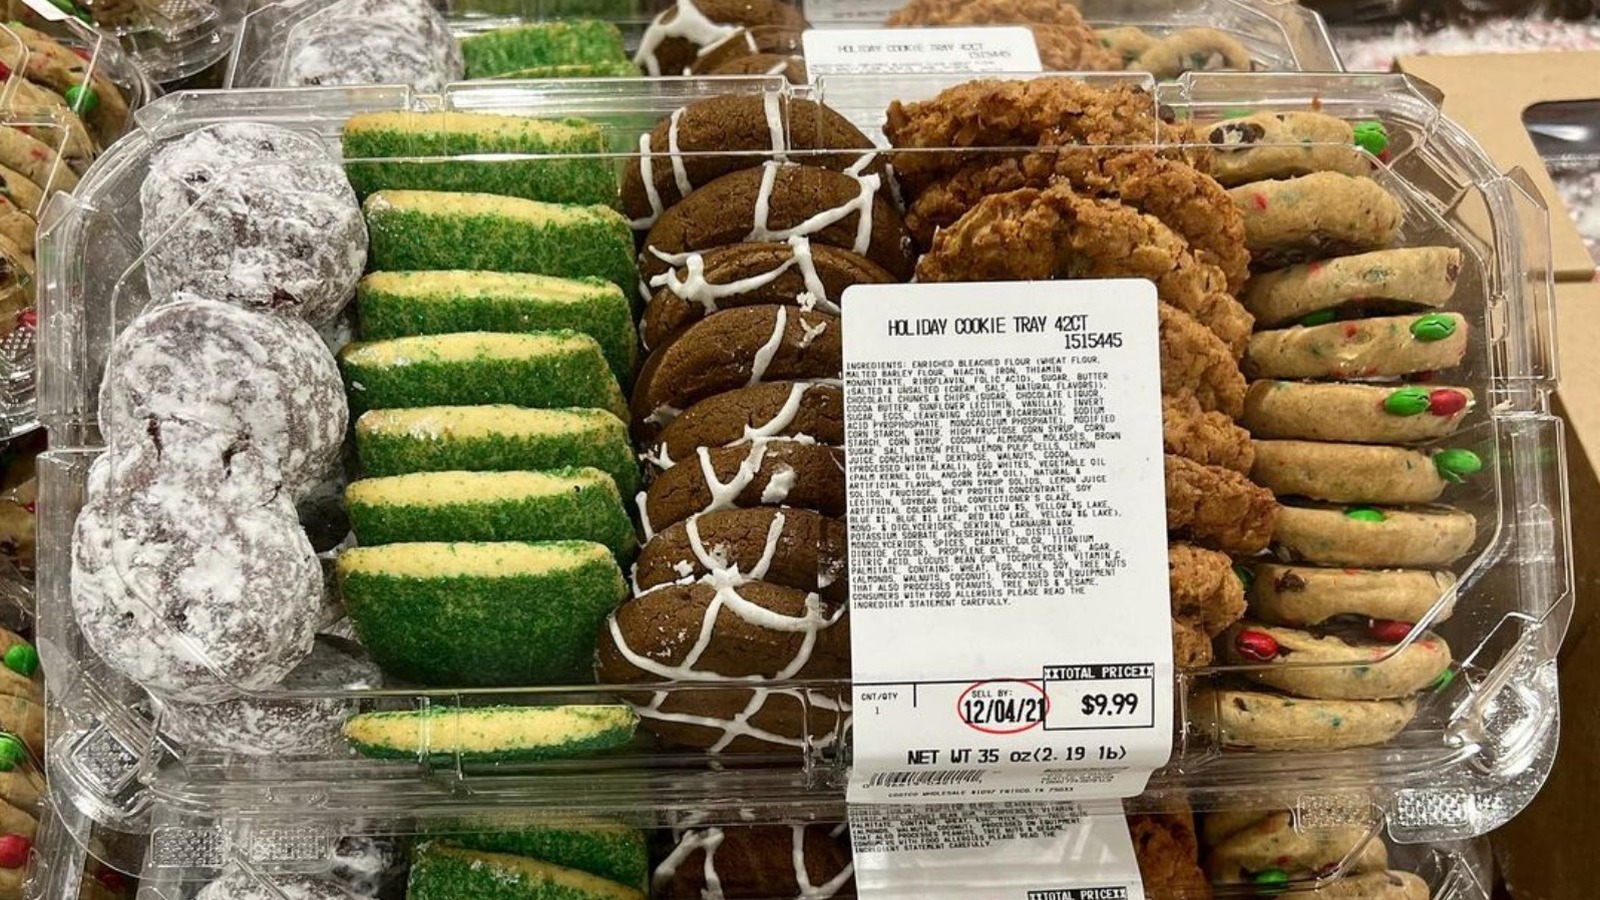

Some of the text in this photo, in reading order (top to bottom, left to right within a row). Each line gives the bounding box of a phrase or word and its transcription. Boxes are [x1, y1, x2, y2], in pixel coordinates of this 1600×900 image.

[888, 314, 1088, 336] HOLIDAY COOKIE TRAY 42CT
[1065, 332, 1123, 350] 1515445
[846, 361, 905, 370] INGREDIENTS:
[912, 360, 952, 368] ENRICHED
[958, 358, 998, 366] BLEACHED
[845, 365, 1061, 378] MALTED BARLEY THIAMIN
[1077, 372, 1107, 380] BUTTER
[897, 386, 938, 394] UNSALTED
[846, 396, 892, 404] CHOCOLATE
[944, 393, 969, 401] CHIPS
[1016, 391, 1061, 399] CHOCOLATE
[918, 402, 964, 410] SUNFLOWER
[1074, 398, 1103, 406] INVERT
[913, 411, 959, 419] LEAVENING
[950, 418, 1006, 426] MONOCALCIUM
[1073, 415, 1114, 423] MODIFIED
[847, 430, 867, 438] CORN
[976, 426, 1016, 434] FRUCTOSE
[1069, 441, 1094, 449] LEMON
[1038, 459, 1084, 467] VEGETABLE
[879, 472, 909, 480] KERNEL
[941, 470, 971, 478] AND/OR
[1034, 467, 1069, 475] NATURAL
[849, 481, 899, 489] ARTIFICIAL
[1080, 475, 1105, 483] JUICE
[967, 486, 1003, 494] PROTEIN
[900, 497, 936, 505] SOYBEAN
[849, 506, 900, 515] ARTIFICIAL
[906, 505, 936, 513] COLORS
[896, 514, 916, 522] BLUE
[1040, 510, 1070, 518] YELLOW
[850, 524, 875, 532] MONO-
[1010, 519, 1050, 527] CARNAUBA
[850, 527, 1071, 540] POTASSIUM SORBATE DISTILLED
[974, 537, 1010, 545] CARAMEL
[1052, 535, 1092, 543] TITANIUM
[851, 549, 886, 557] DIOXIDE
[939, 547, 984, 555] PROPYLENE
[851, 558, 881, 566] CITRIC
[918, 556, 948, 564] LOCUST
[1073, 552, 1109, 560] VITAMIN
[908, 565, 952, 573] CONTAINS:
[1002, 571, 1047, 579] PROCESSED
[1069, 569, 1115, 577] EQUIPMENT
[878, 583, 897, 591] ALSO
[904, 582, 949, 590] PROCESSES
[852, 592, 898, 600] CONSUMERS
[930, 590, 949, 598] FOOD
[955, 589, 1001, 597] ALLERGIES
[1007, 588, 1037, 596] PLEASE
[1043, 587, 1063, 595] READ
[853, 600, 903, 608] INGREDIENT
[909, 599, 955, 607] STATEMENT
[861, 692, 898, 702] CNT/QTY
[972, 689, 1013, 698] SELL BY:
[964, 698, 1045, 723] 12/04/21
[1081, 693, 1138, 717] $9.99
[907, 750, 940, 765] NET
[950, 749, 972, 764] WT
[977, 748, 1000, 764] 35
